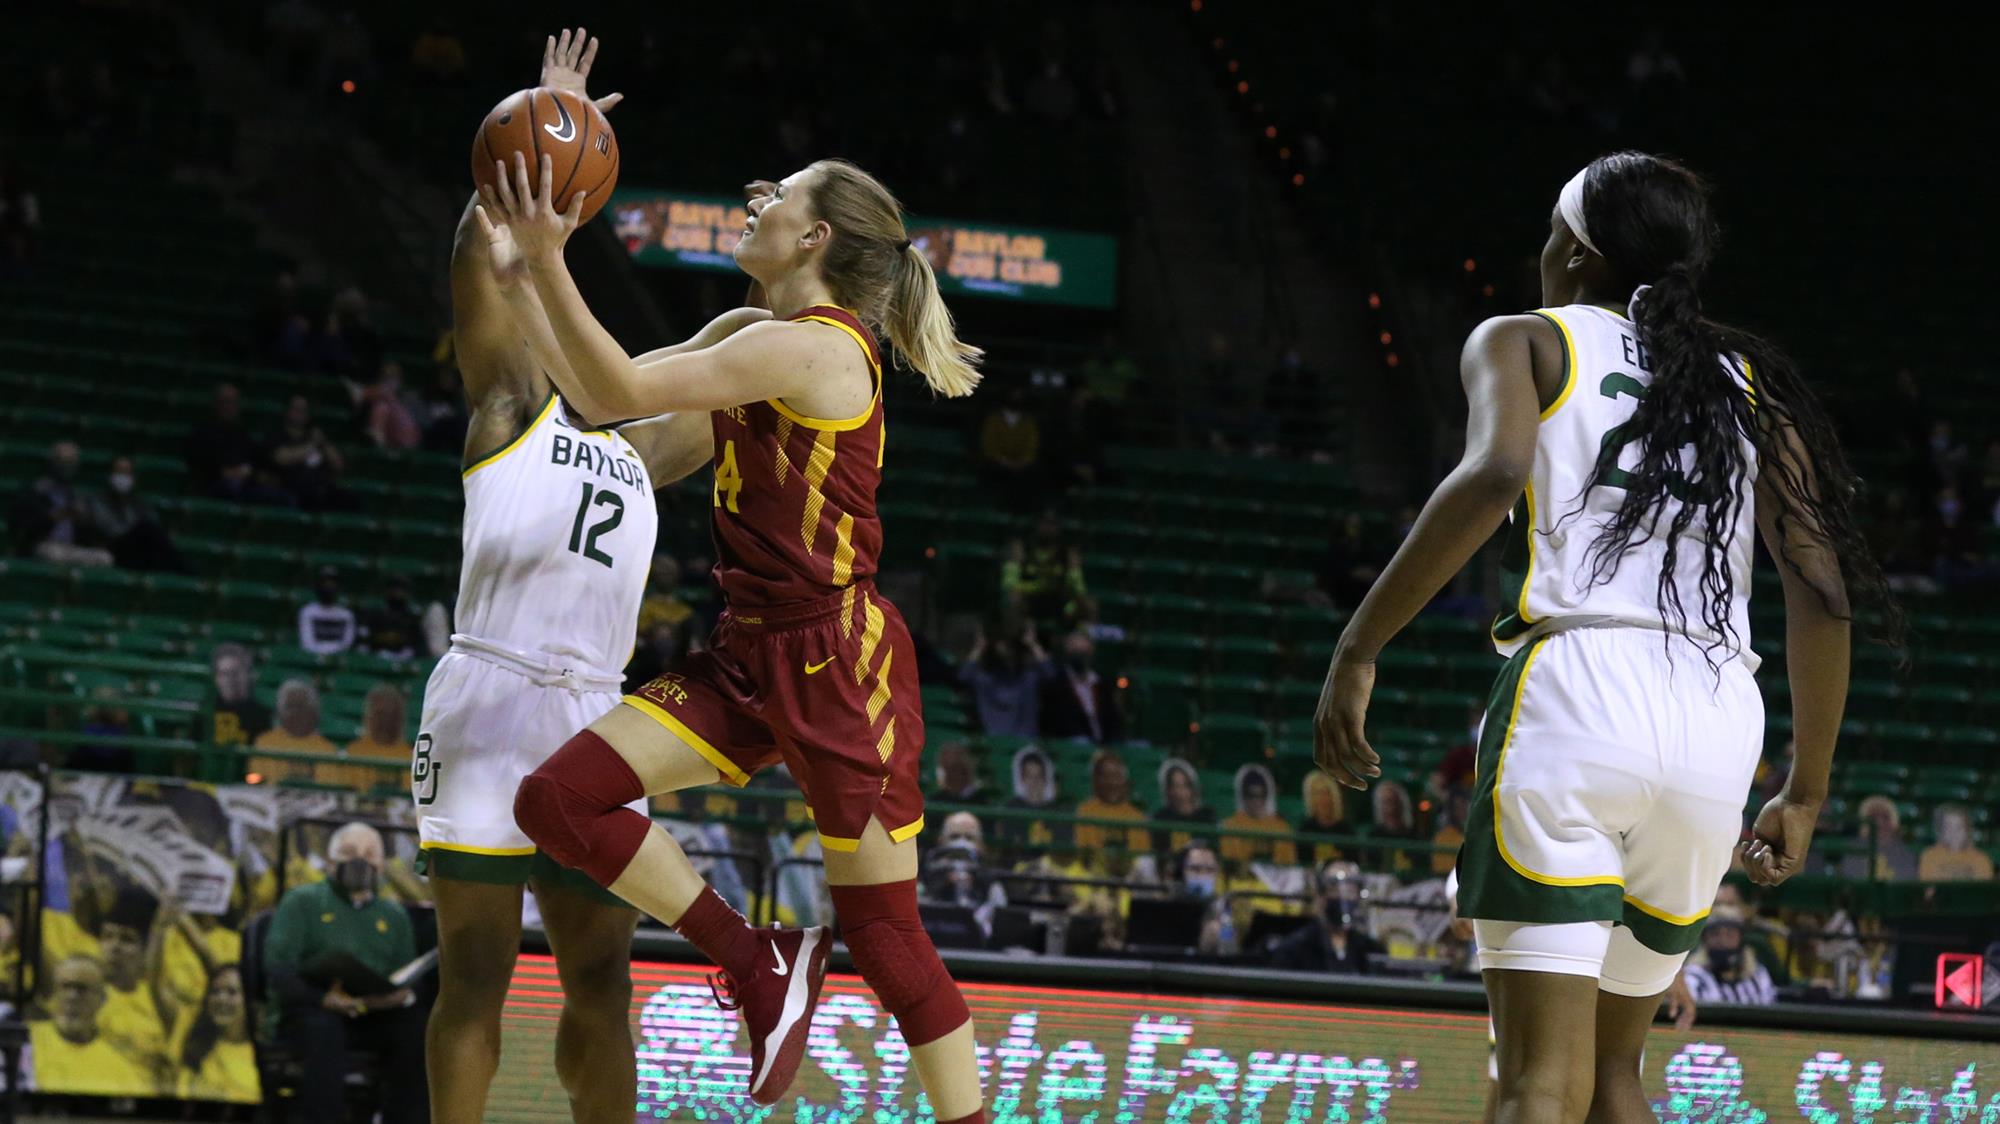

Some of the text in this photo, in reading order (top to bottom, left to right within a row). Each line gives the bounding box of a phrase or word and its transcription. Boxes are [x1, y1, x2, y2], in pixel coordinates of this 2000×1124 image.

[1620, 333, 1652, 373] EG
[551, 434, 646, 497] BAYLOR
[568, 482, 625, 569] 12
